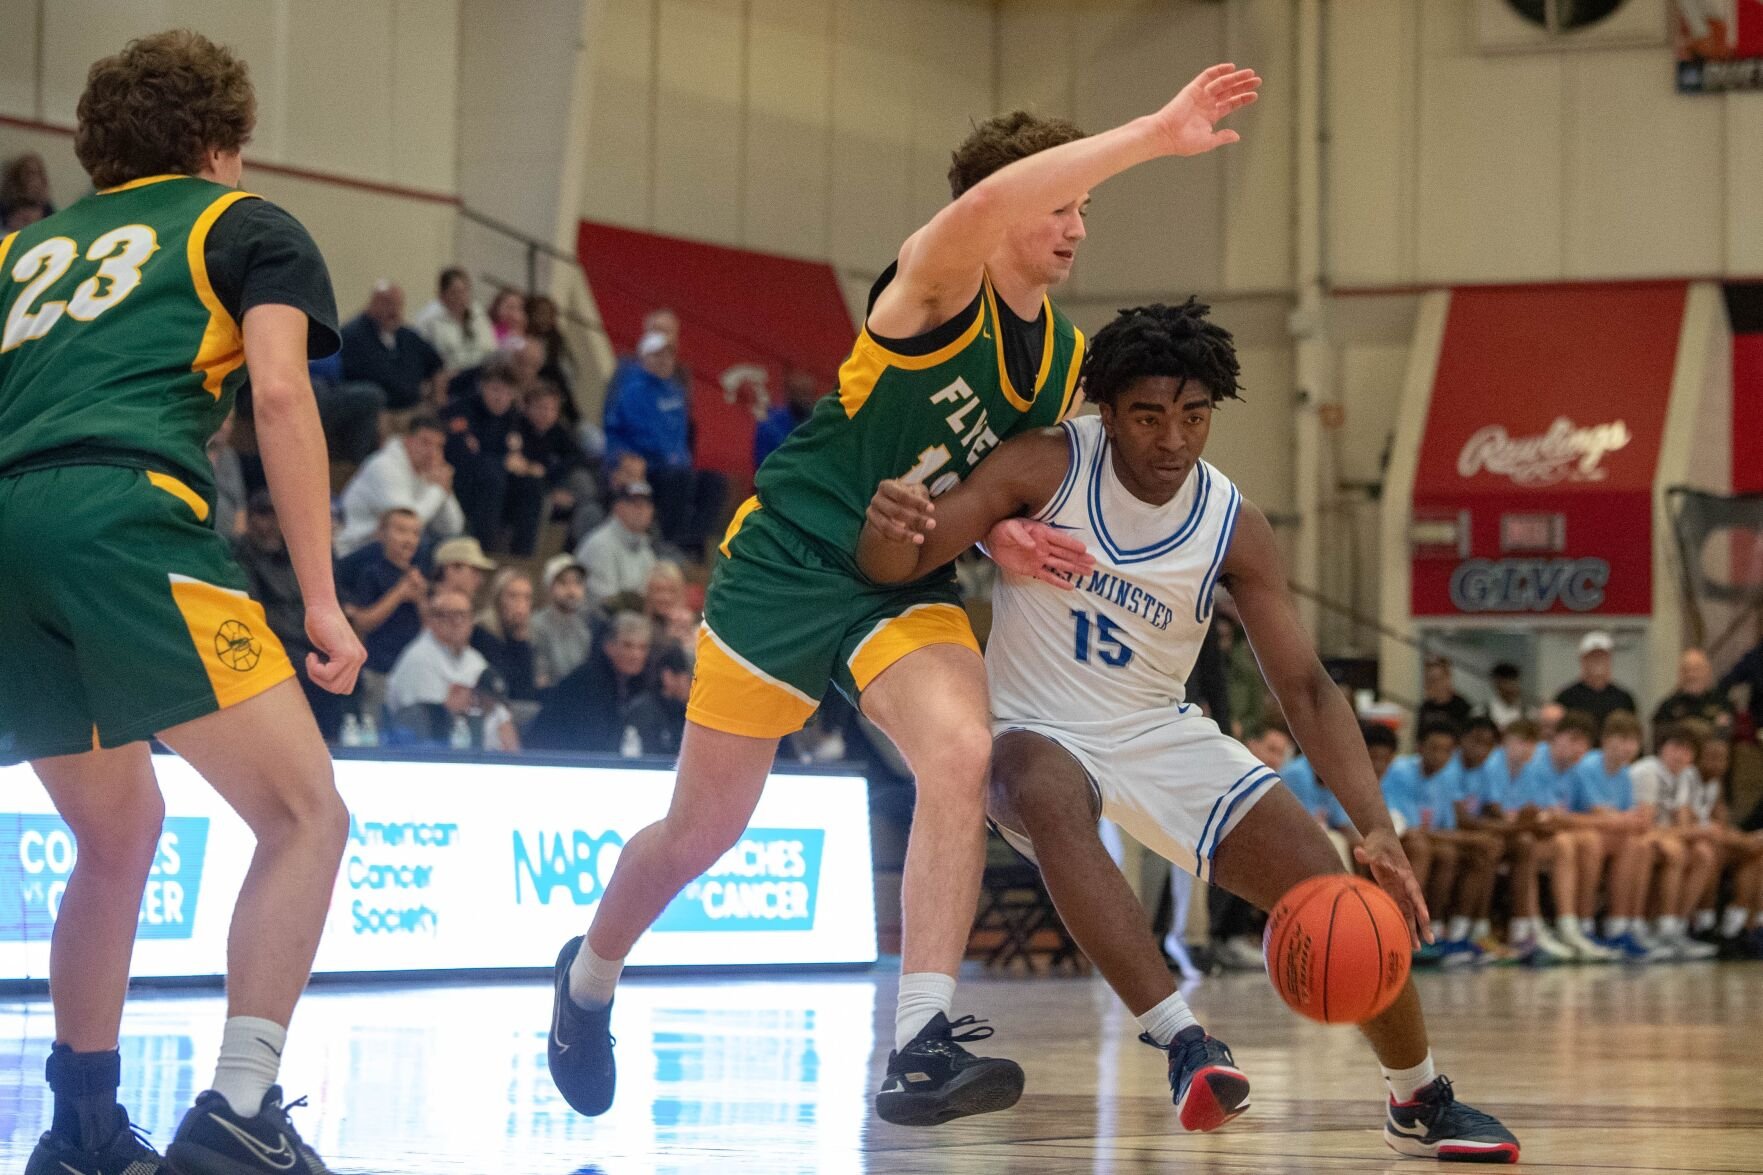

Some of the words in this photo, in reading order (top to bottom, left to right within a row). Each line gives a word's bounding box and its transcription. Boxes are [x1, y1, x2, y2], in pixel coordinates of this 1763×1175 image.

[1, 224, 160, 353] 23
[929, 376, 1002, 466] FLYE
[1032, 565, 1173, 631] TMINSTER
[1450, 557, 1610, 613] GLVC
[1069, 608, 1135, 670] 15
[702, 881, 808, 919] CANCER
